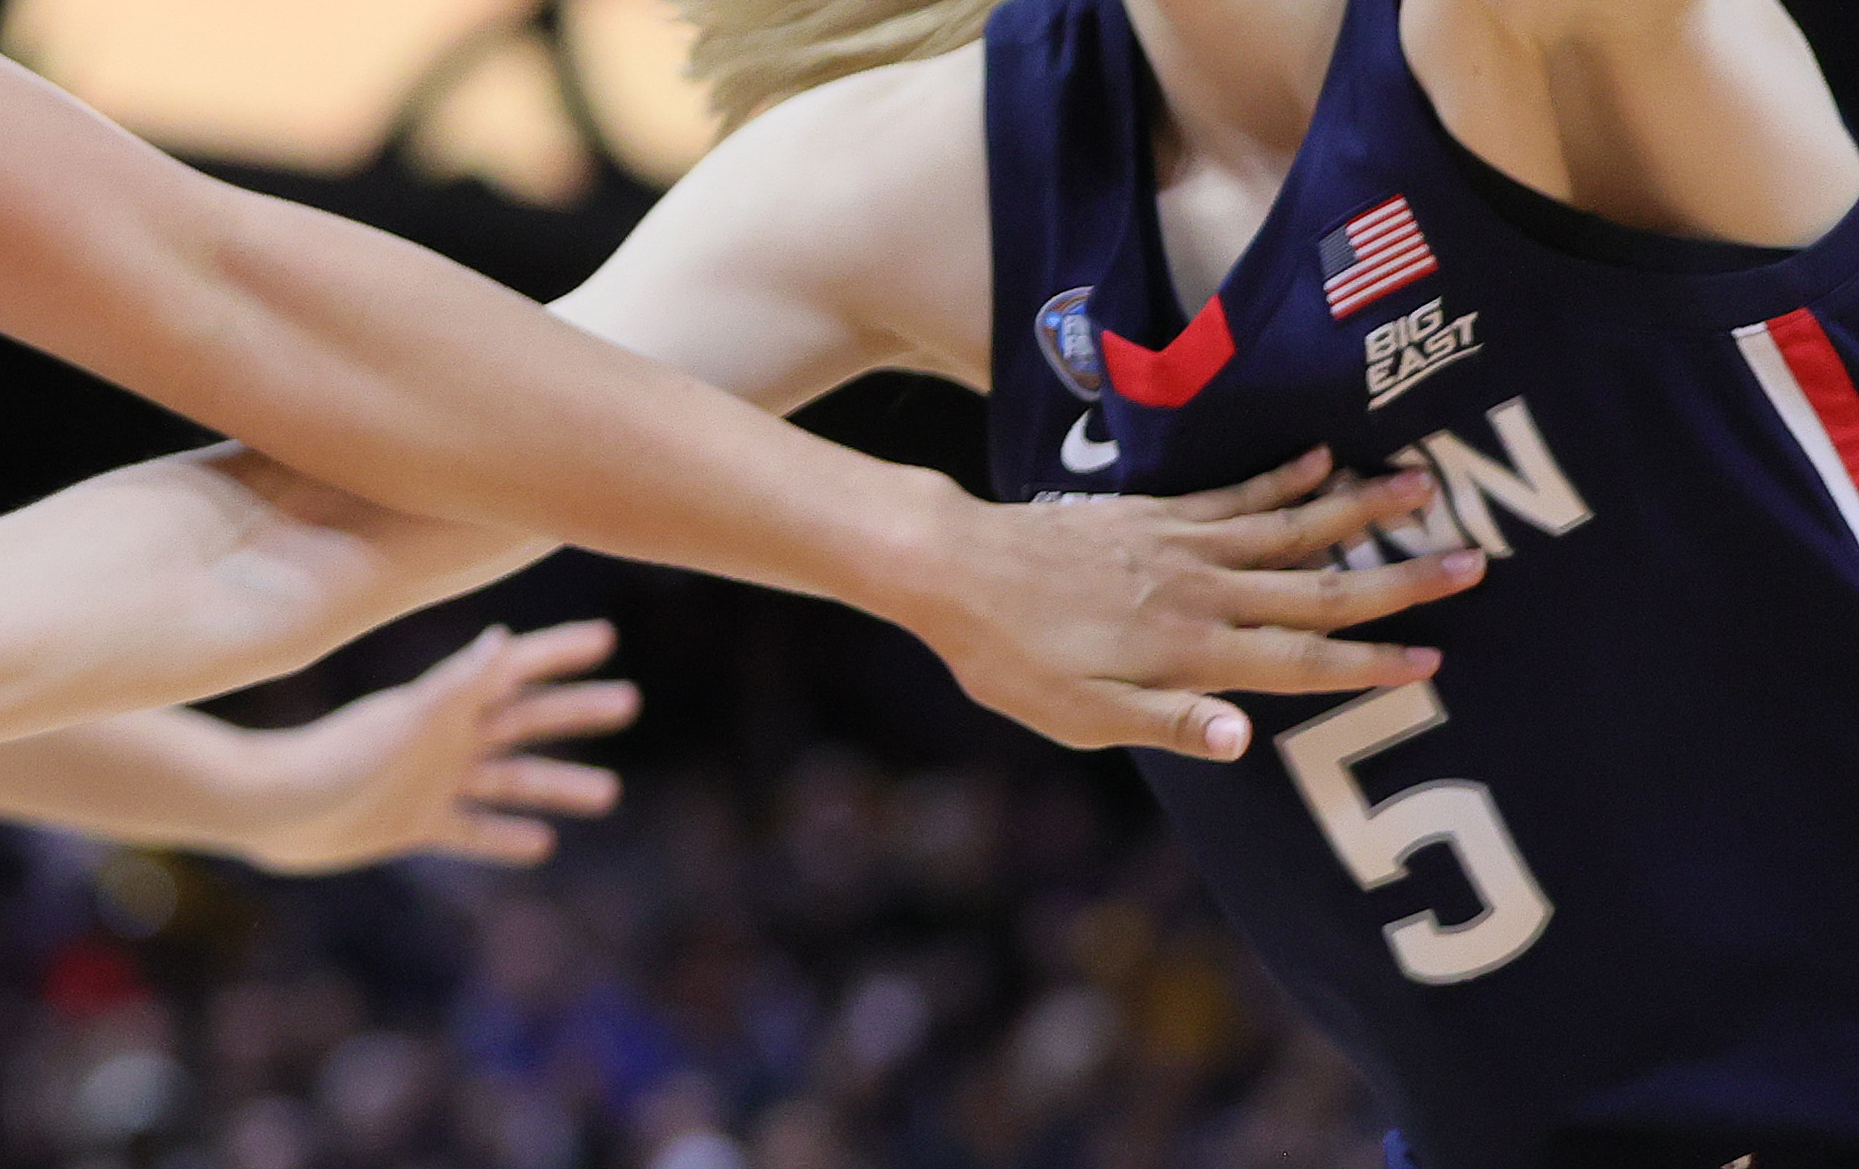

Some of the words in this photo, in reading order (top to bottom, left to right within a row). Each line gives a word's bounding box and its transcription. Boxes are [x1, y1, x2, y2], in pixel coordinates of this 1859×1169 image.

[1364, 294, 1444, 365] BIG
[1365, 310, 1480, 396] EAST
[1274, 678, 1556, 986] 5
